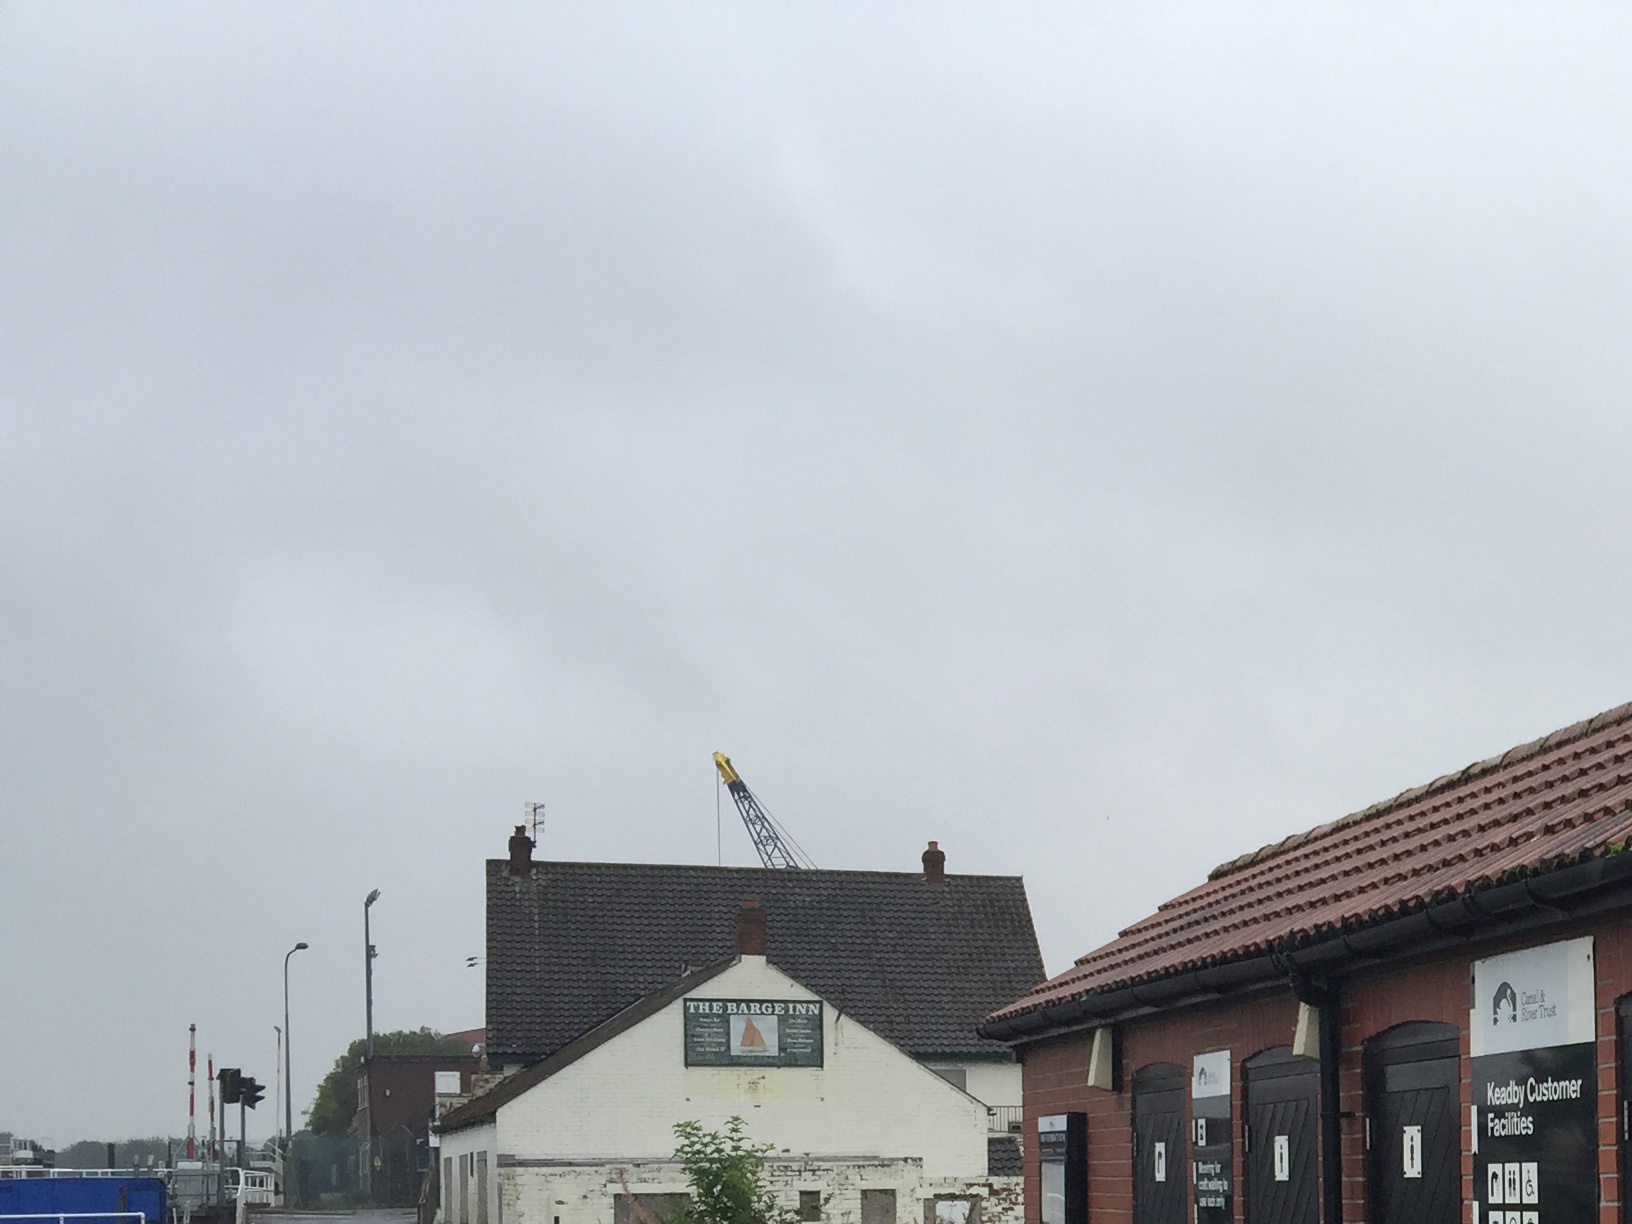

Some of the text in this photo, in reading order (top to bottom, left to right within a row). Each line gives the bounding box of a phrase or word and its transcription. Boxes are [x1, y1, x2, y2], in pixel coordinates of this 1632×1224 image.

[686, 1001, 820, 1015] THE BARGE INN
[1487, 1076, 1582, 1108] Keadby Customer
[1487, 1111, 1534, 1137] Facilities
